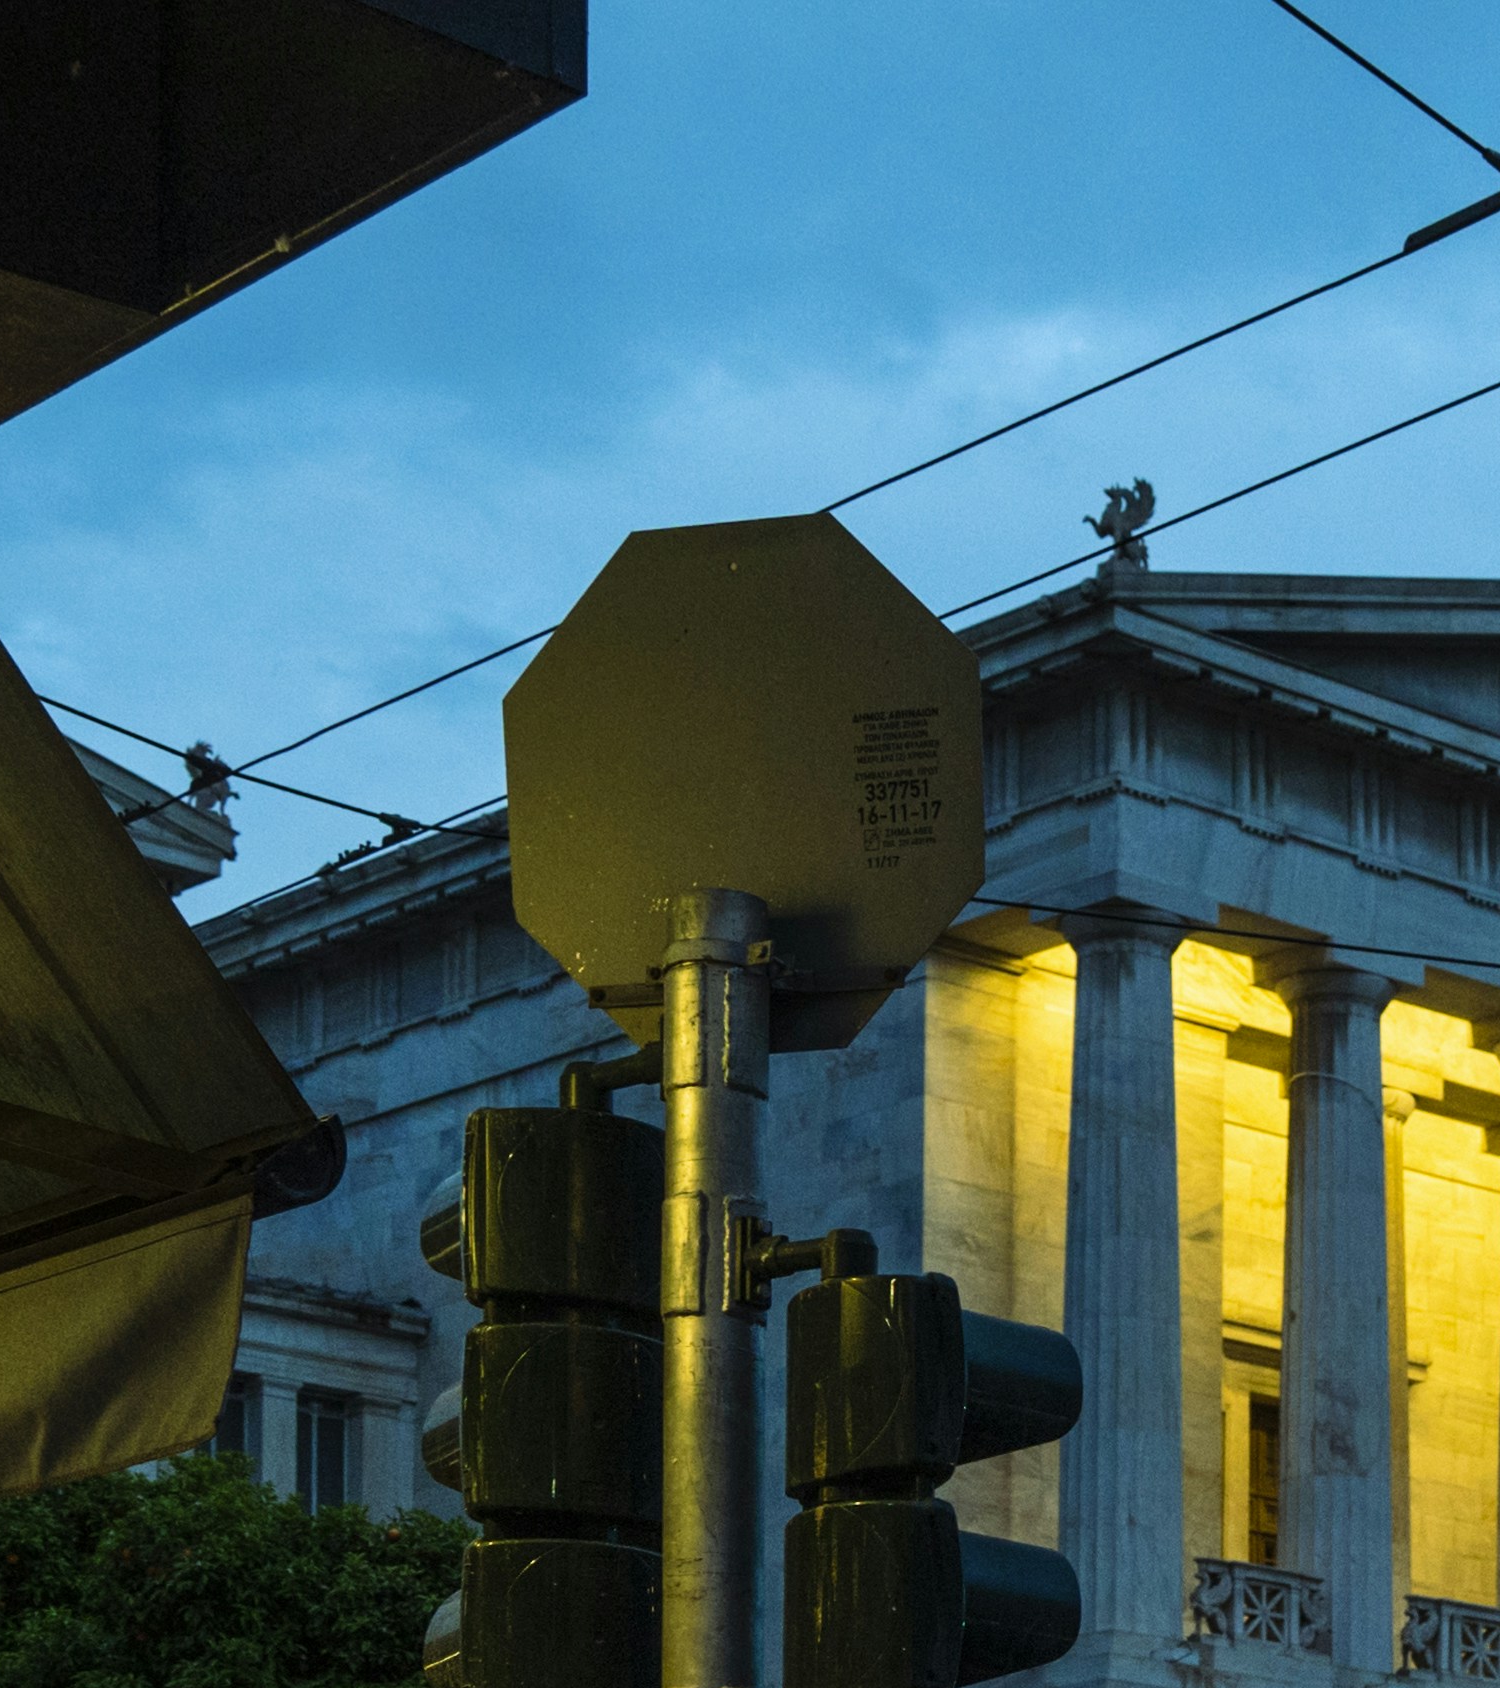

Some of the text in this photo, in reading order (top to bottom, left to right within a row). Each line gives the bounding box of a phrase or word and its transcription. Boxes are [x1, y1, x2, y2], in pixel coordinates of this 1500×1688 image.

[852, 711, 887, 723] ΔΗΜΟΣ
[864, 778, 929, 802] 337751
[857, 800, 942, 825] 16-11-17
[867, 854, 900, 868] 11/17
